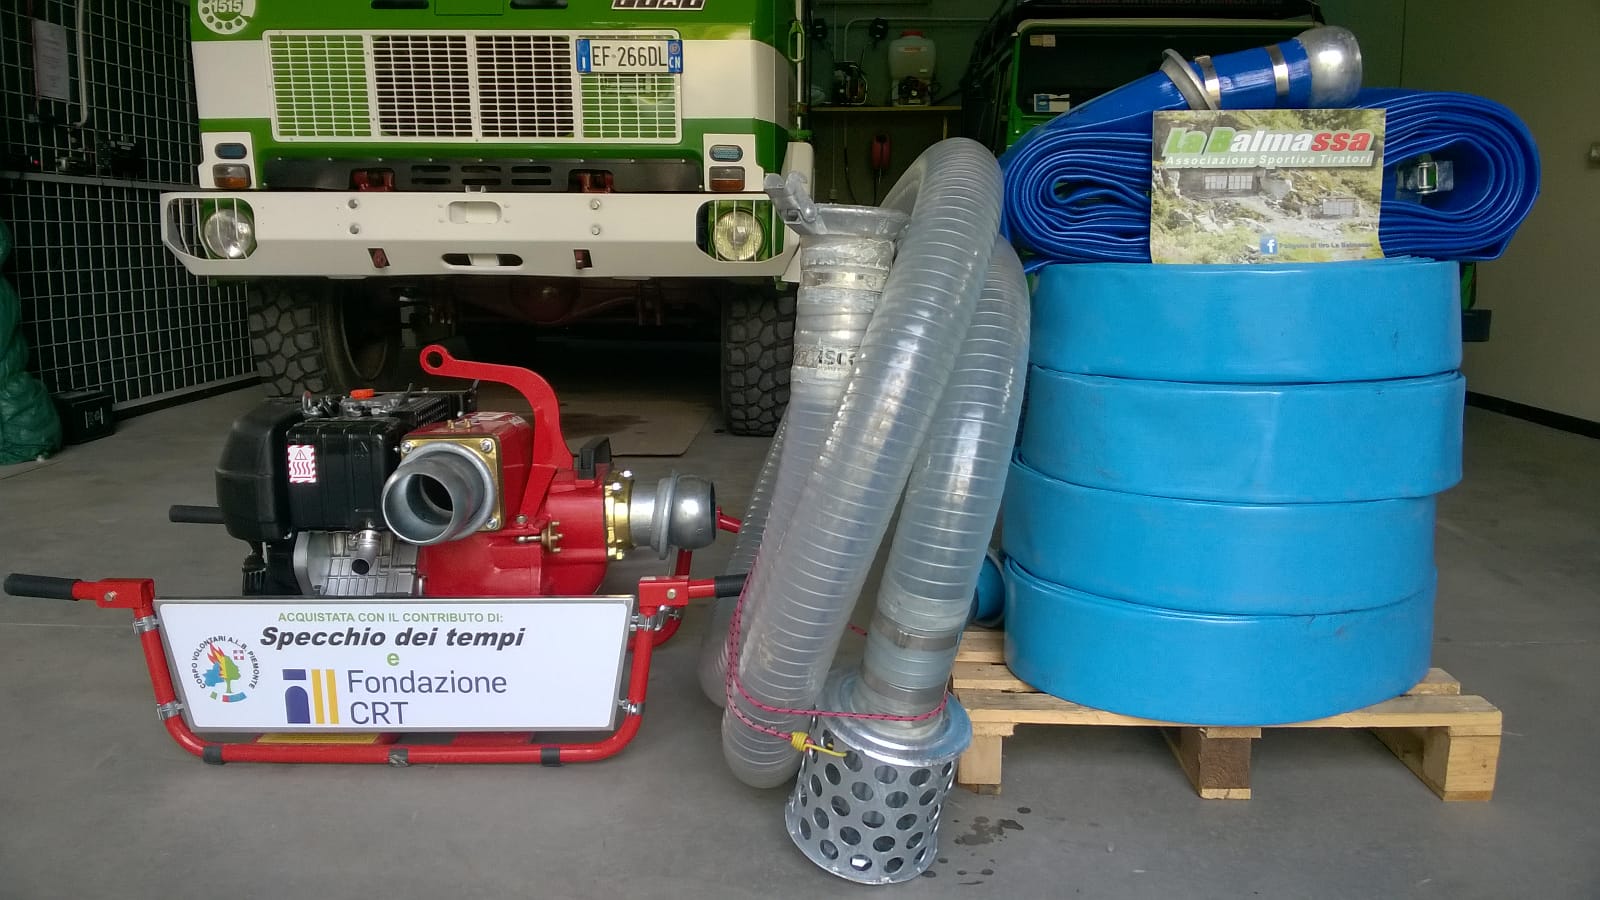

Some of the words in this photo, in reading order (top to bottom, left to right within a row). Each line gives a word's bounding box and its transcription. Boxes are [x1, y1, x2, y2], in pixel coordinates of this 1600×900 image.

[212, 0, 242, 13] 1515
[617, 45, 668, 67] 266DL
[668, 56, 681, 69] CN
[1164, 127, 1206, 156] La
[1205, 127, 1373, 153] Balmassa
[1166, 155, 1256, 166] Associazione
[1258, 154, 1316, 167] Sportiva
[1319, 153, 1373, 165] Tiratori
[278, 612, 355, 623] ACQUISTATA
[357, 612, 387, 623] CON
[388, 612, 400, 623] IL
[402, 612, 484, 623] CONTRIBUTO
[487, 613, 504, 623] DI:
[191, 635, 226, 661] VOLONTARI
[259, 626, 386, 650] Specchio
[394, 627, 438, 646] dei
[446, 627, 526, 650] tempi
[247, 650, 260, 690] PIEMONTE
[386, 652, 400, 667] e
[191, 662, 206, 689] CORPO
[347, 669, 508, 694] Fondazione
[349, 701, 409, 725] CRT
